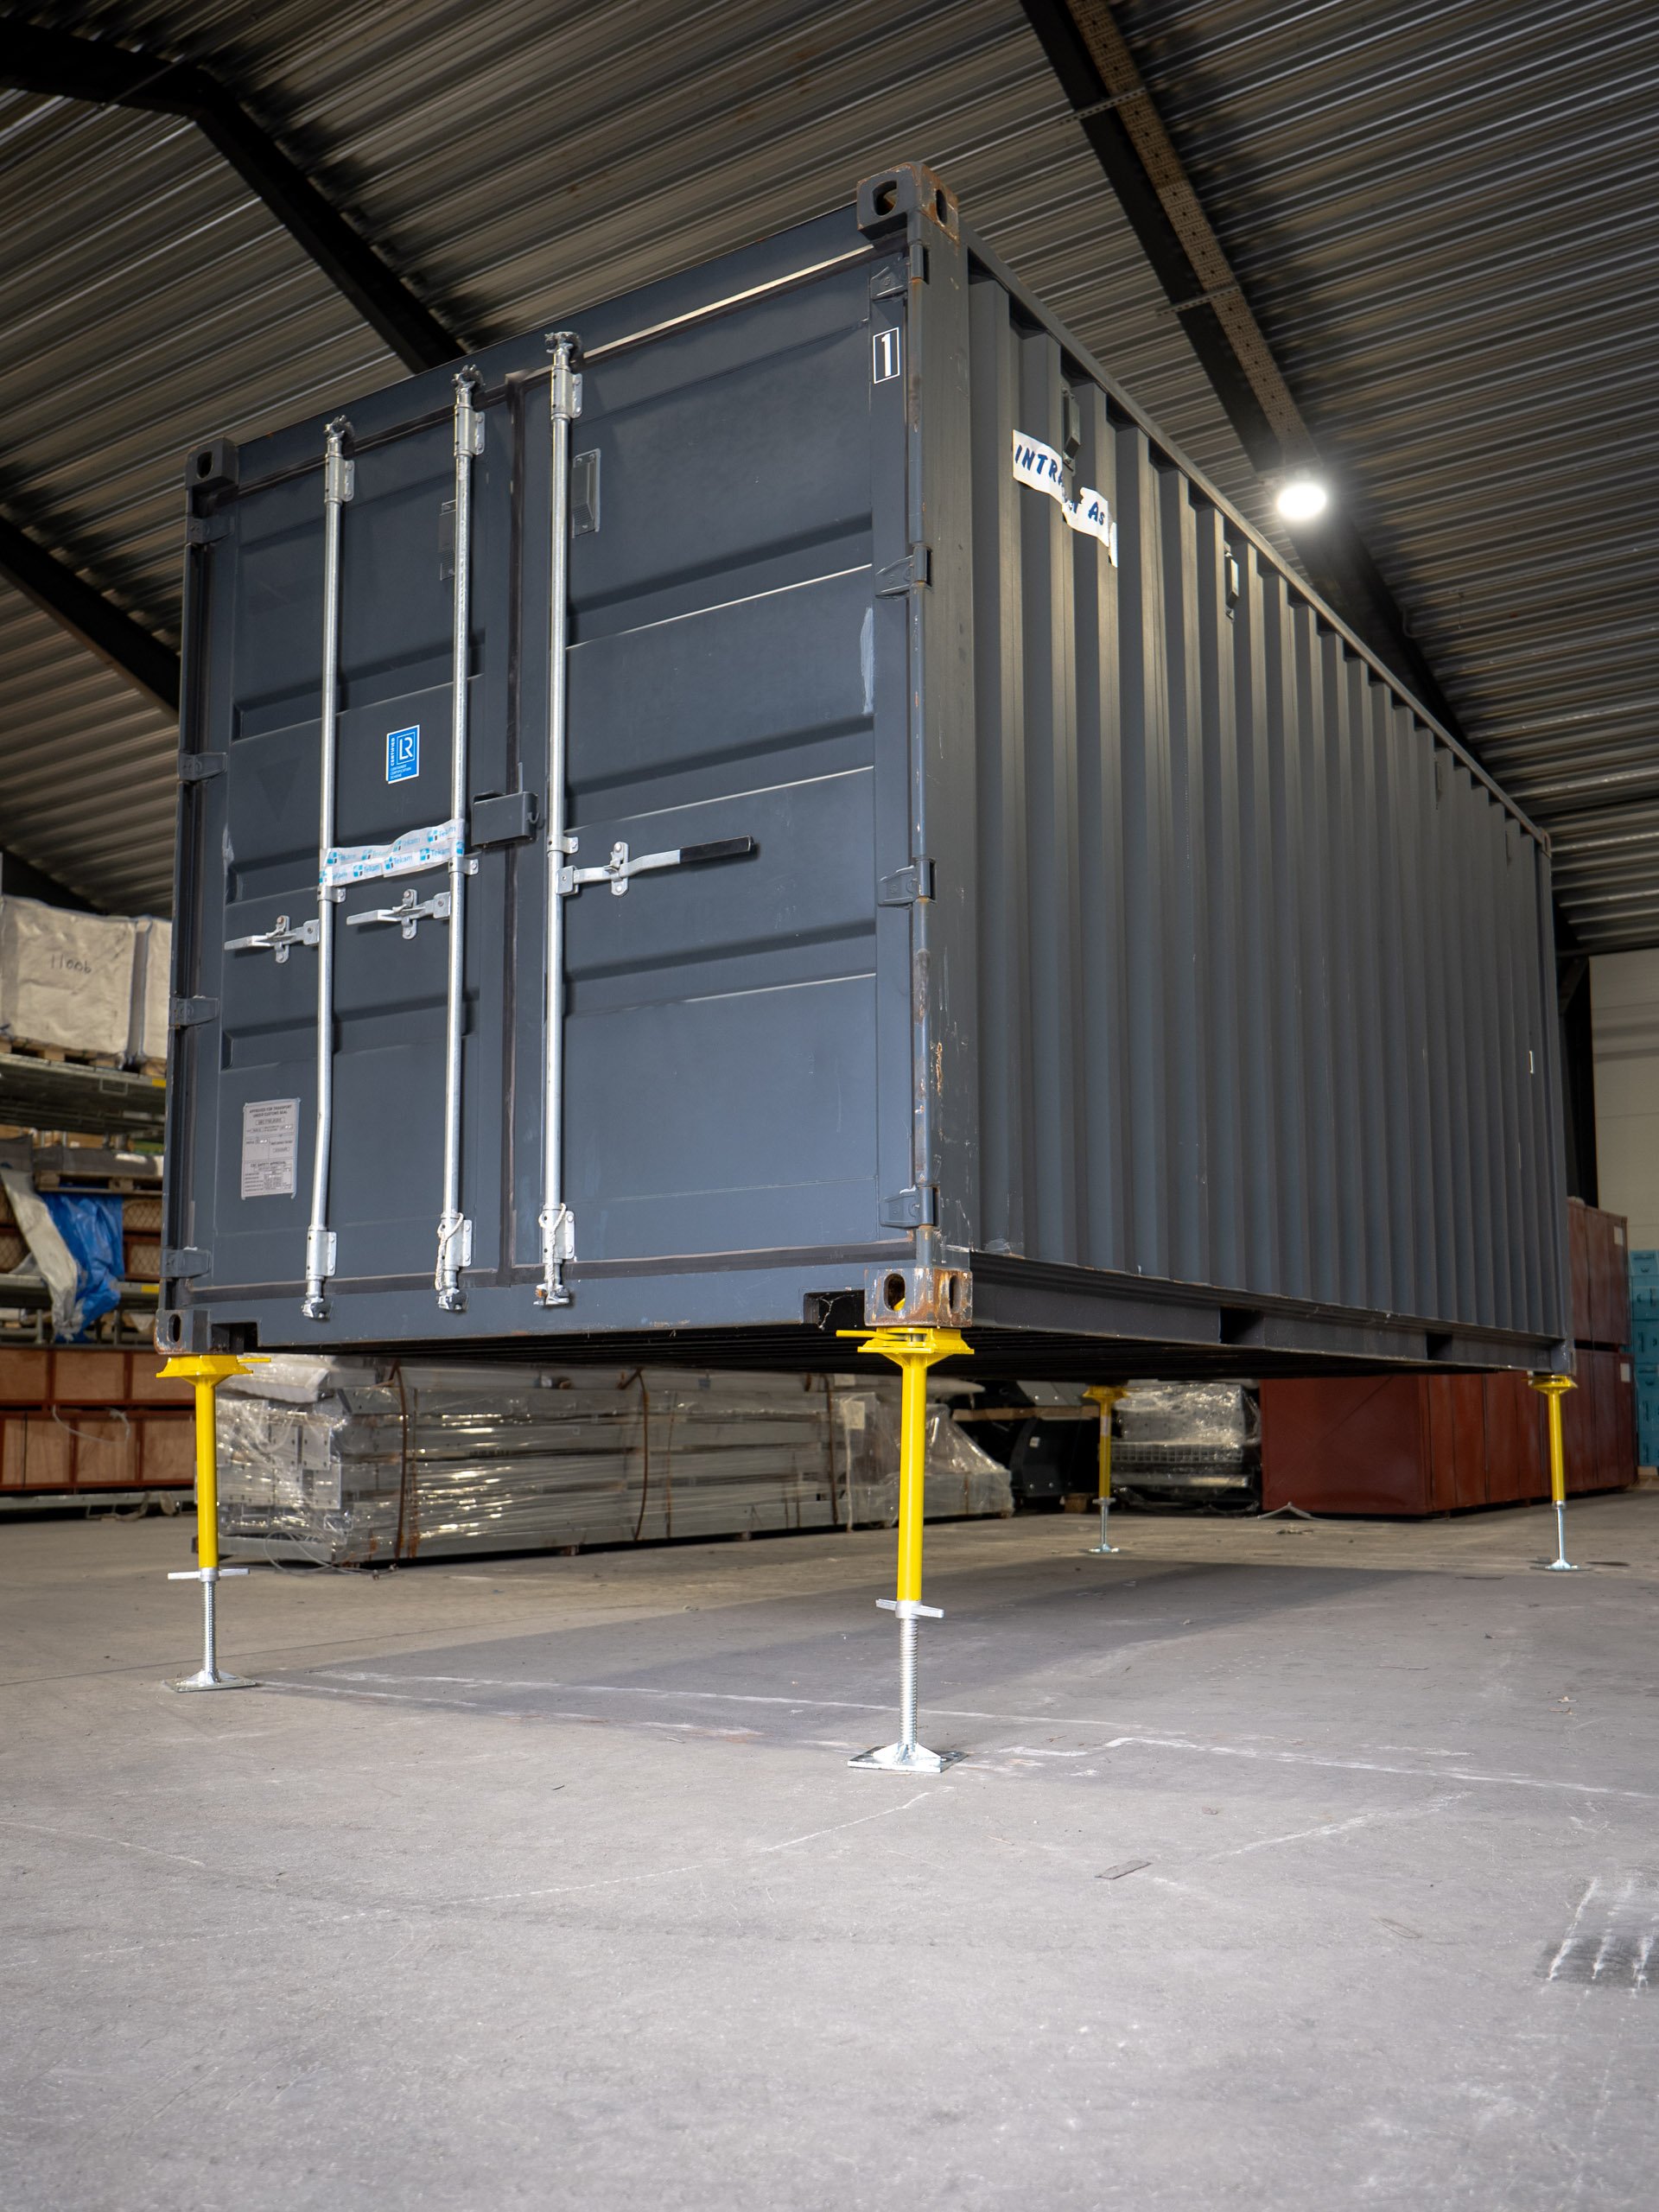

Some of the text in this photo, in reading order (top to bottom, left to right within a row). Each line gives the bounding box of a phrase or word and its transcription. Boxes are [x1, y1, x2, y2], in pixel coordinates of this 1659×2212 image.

[881, 333, 891, 378] 1
[399, 737, 413, 760] LR
[394, 855, 413, 864] Tekam
